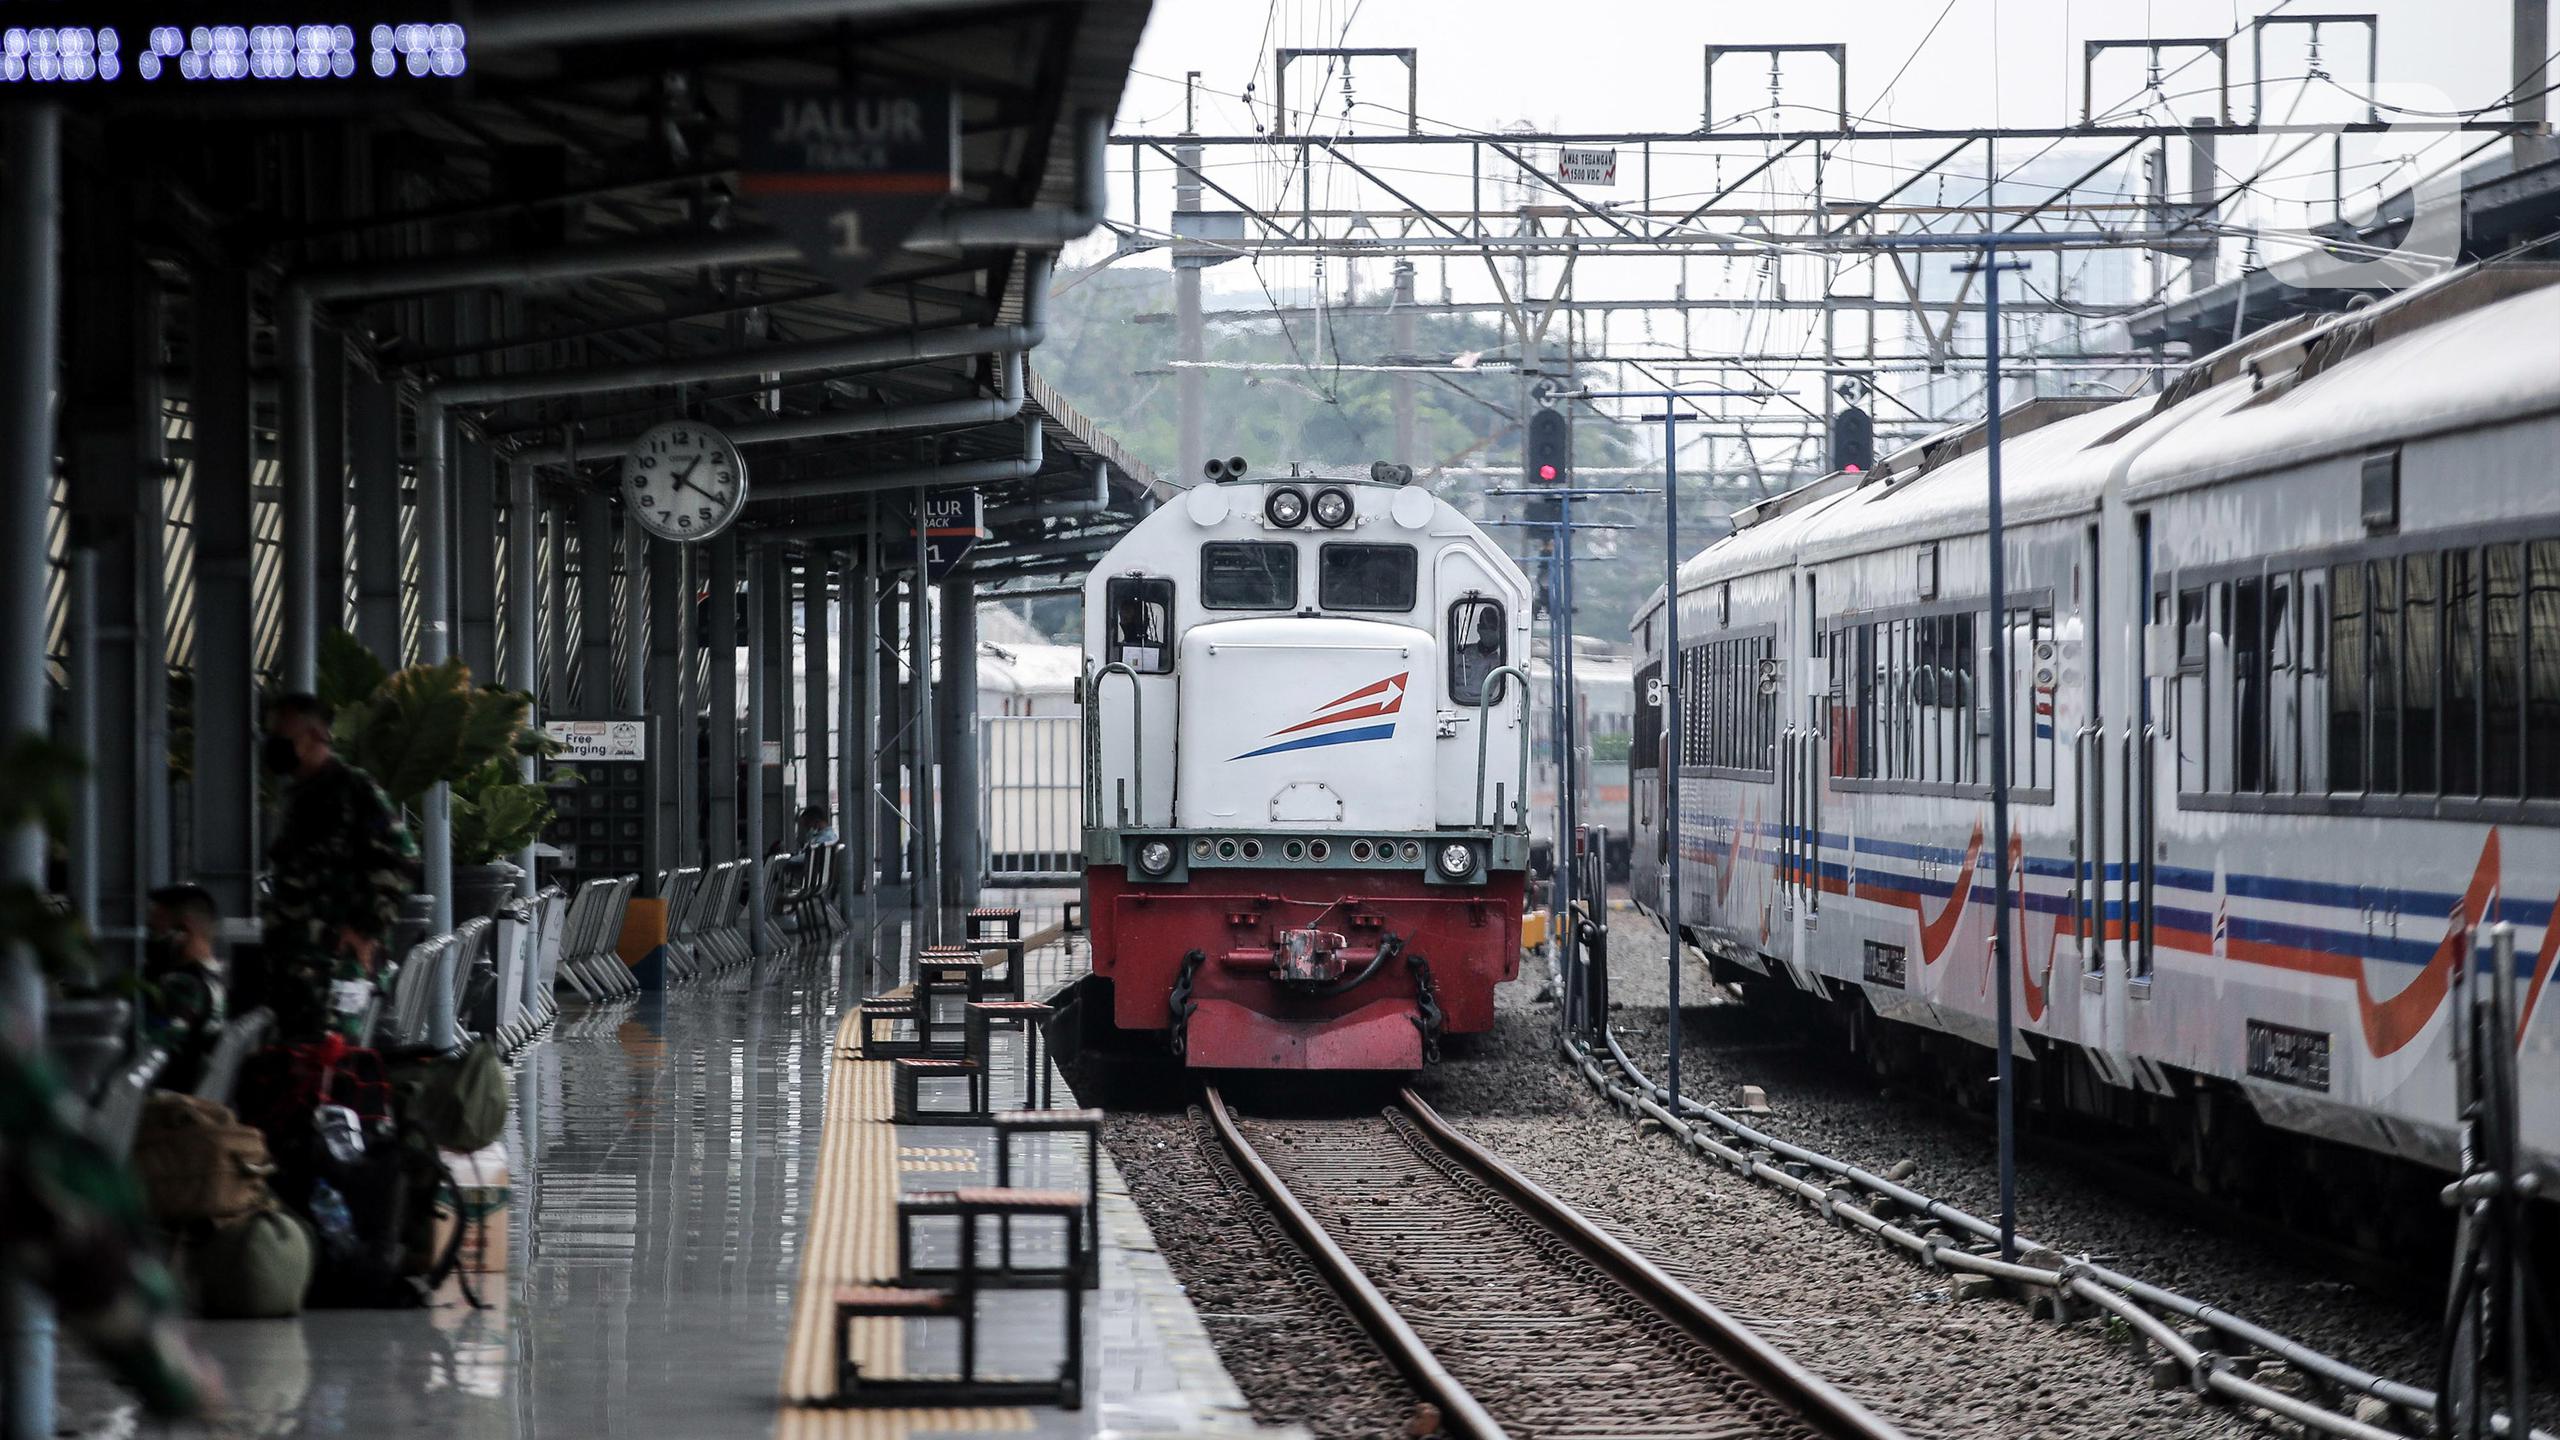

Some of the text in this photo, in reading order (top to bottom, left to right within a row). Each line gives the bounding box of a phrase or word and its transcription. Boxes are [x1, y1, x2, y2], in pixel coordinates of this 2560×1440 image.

[772, 98, 924, 143] JALUR
[1563, 153, 1613, 166] AWAS TEGANGAN
[1570, 168, 1600, 180] 1500 VDC
[829, 212, 870, 256] 1
[1843, 377, 1861, 405] 3
[672, 432, 688, 444] 12
[651, 441, 666, 453] 11
[639, 457, 655, 468] 10
[711, 452, 723, 464] 2
[634, 475, 647, 488] 9
[717, 472, 730, 483] 3
[641, 495, 654, 507] 8
[699, 508, 712, 520] 5
[909, 500, 963, 516] LUR
[658, 511, 671, 523] 7
[678, 515, 691, 527] 6
[924, 517, 950, 528] RACK
[925, 544, 945, 563] 1
[566, 733, 592, 743] Free
